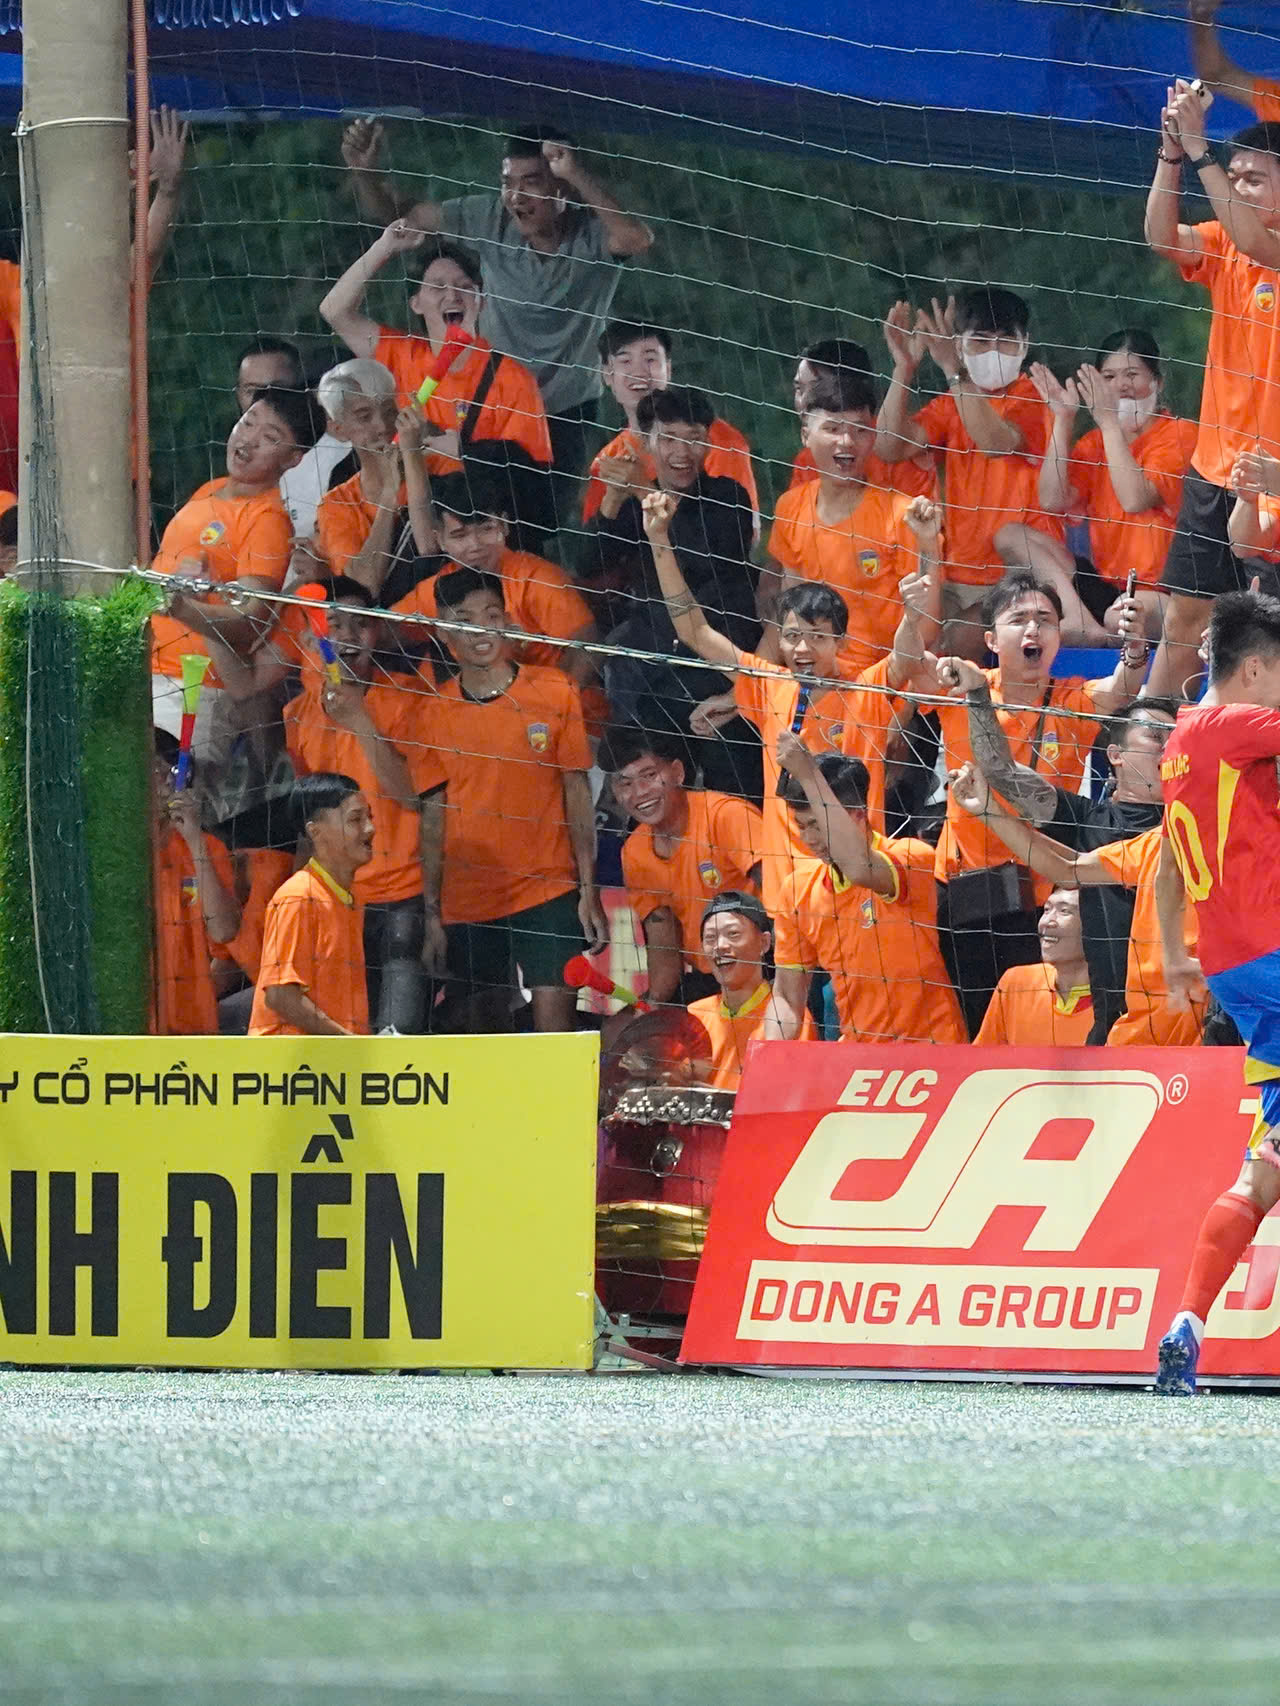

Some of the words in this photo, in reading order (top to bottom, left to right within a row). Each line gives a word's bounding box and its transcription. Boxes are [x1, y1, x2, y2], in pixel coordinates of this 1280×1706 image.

[34, 1057, 89, 1105] CỔ
[105, 1060, 217, 1106] PHẦN
[233, 1063, 346, 1106] PHÂN
[361, 1063, 449, 1106] BÓN
[837, 1069, 938, 1107] EIC
[162, 1114, 445, 1341] ĐIỀN
[751, 1278, 899, 1325] DONG
[907, 1283, 941, 1326] A
[959, 1284, 1142, 1331] GROUP
